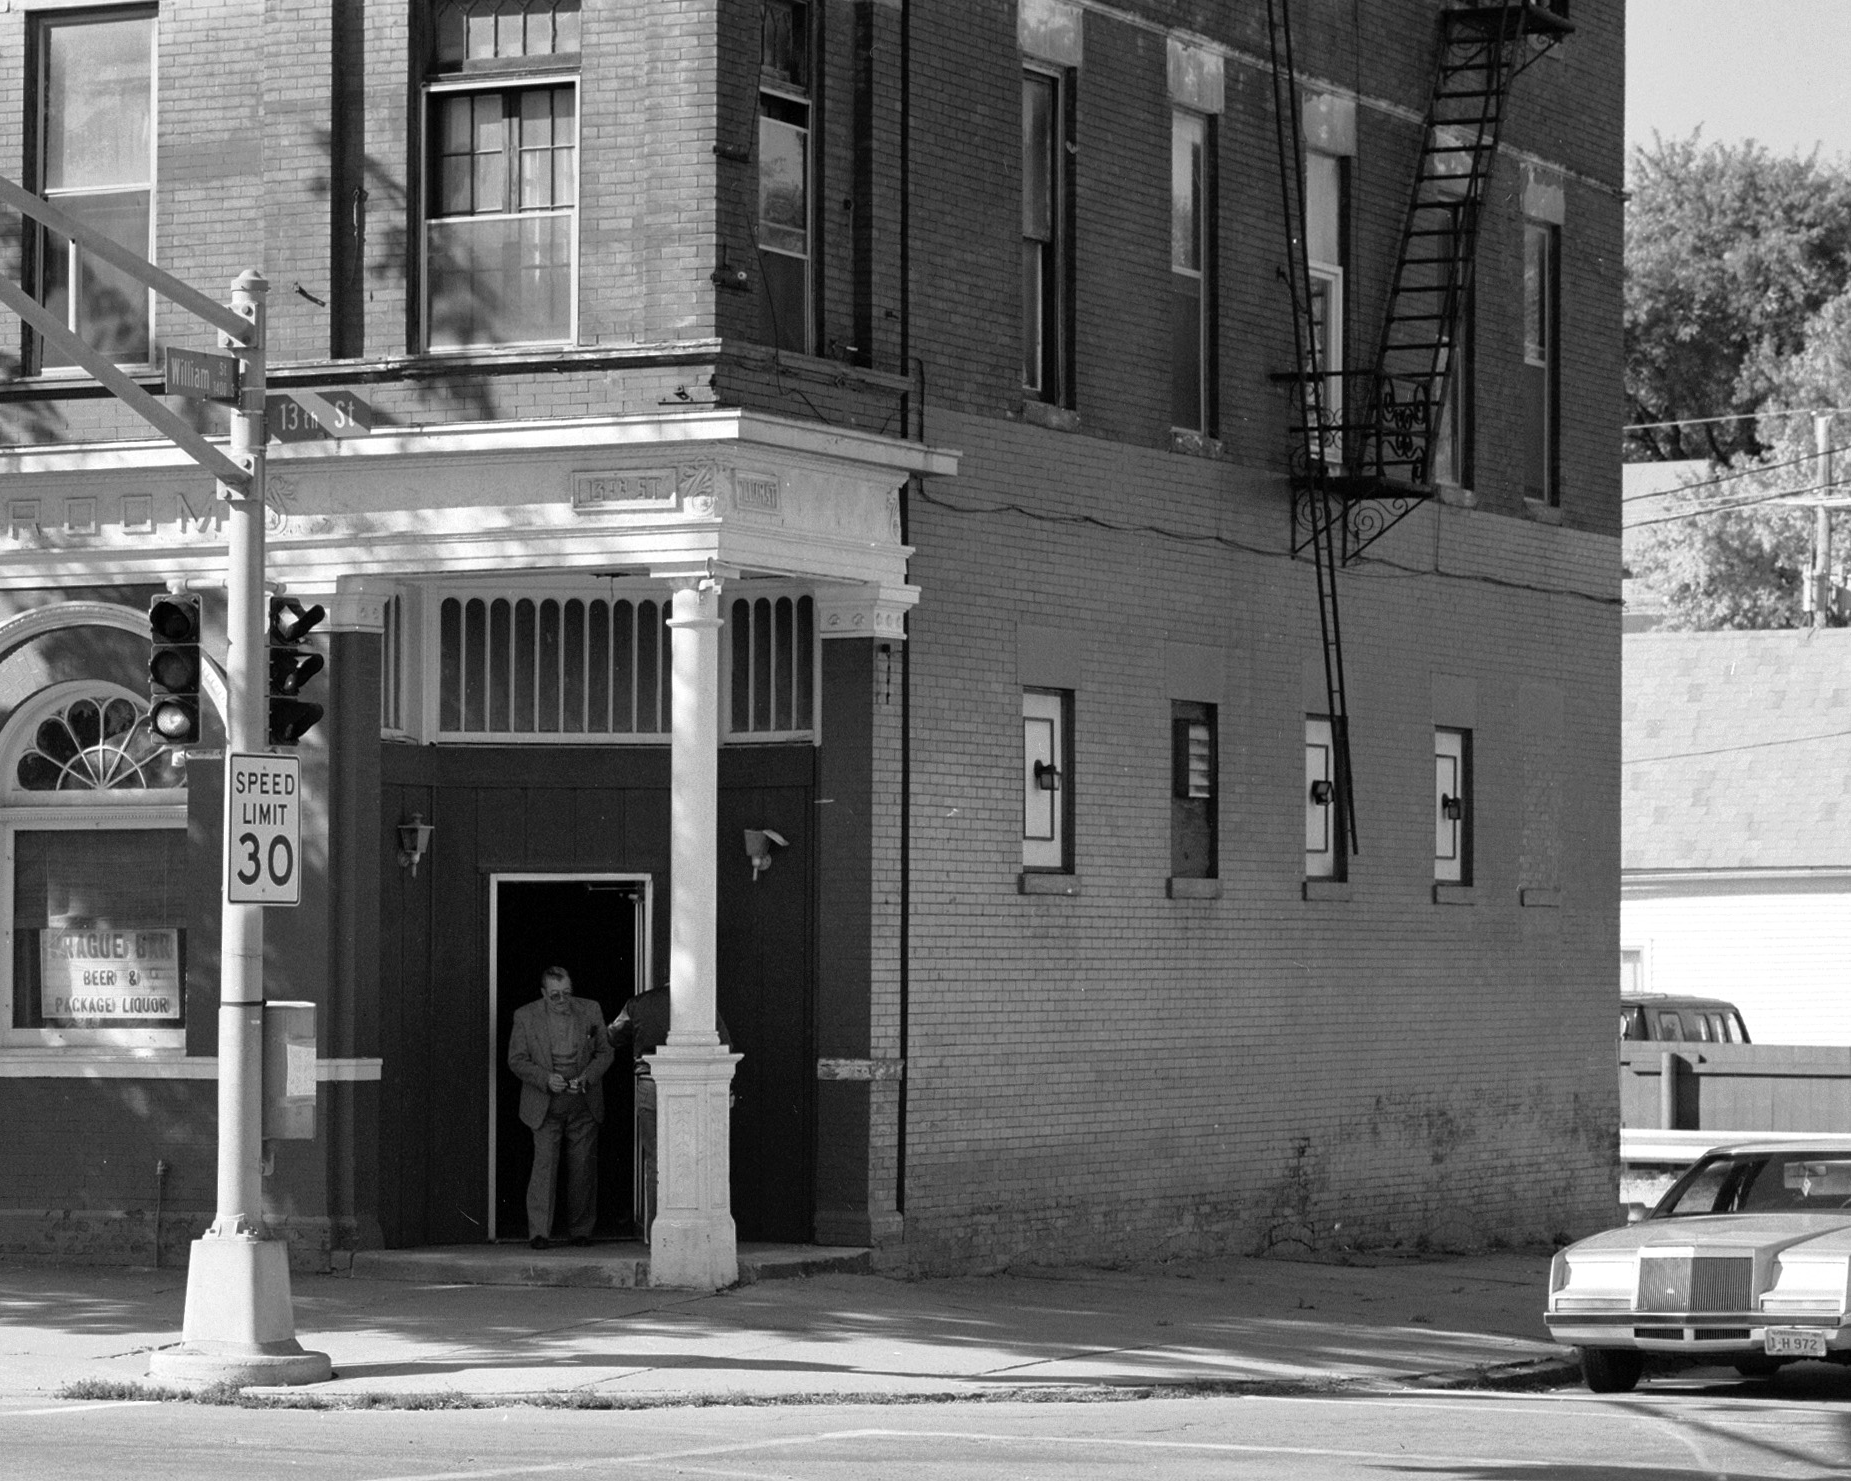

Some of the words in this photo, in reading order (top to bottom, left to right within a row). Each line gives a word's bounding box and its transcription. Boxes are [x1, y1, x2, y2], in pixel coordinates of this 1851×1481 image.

[171, 357, 210, 390] William
[218, 361, 227, 377] St
[280, 403, 318, 430] 13th
[334, 400, 355, 429] St
[6, 491, 224, 541] ROOM
[236, 771, 295, 795] SPEED
[243, 803, 287, 825] LIMIT
[237, 832, 293, 886] 30
[50, 932, 125, 960] RAGUE
[83, 970, 115, 986] BEER
[128, 970, 139, 986] &
[55, 997, 114, 1013] PACKAGE
[122, 997, 169, 1014] LIQUOR
